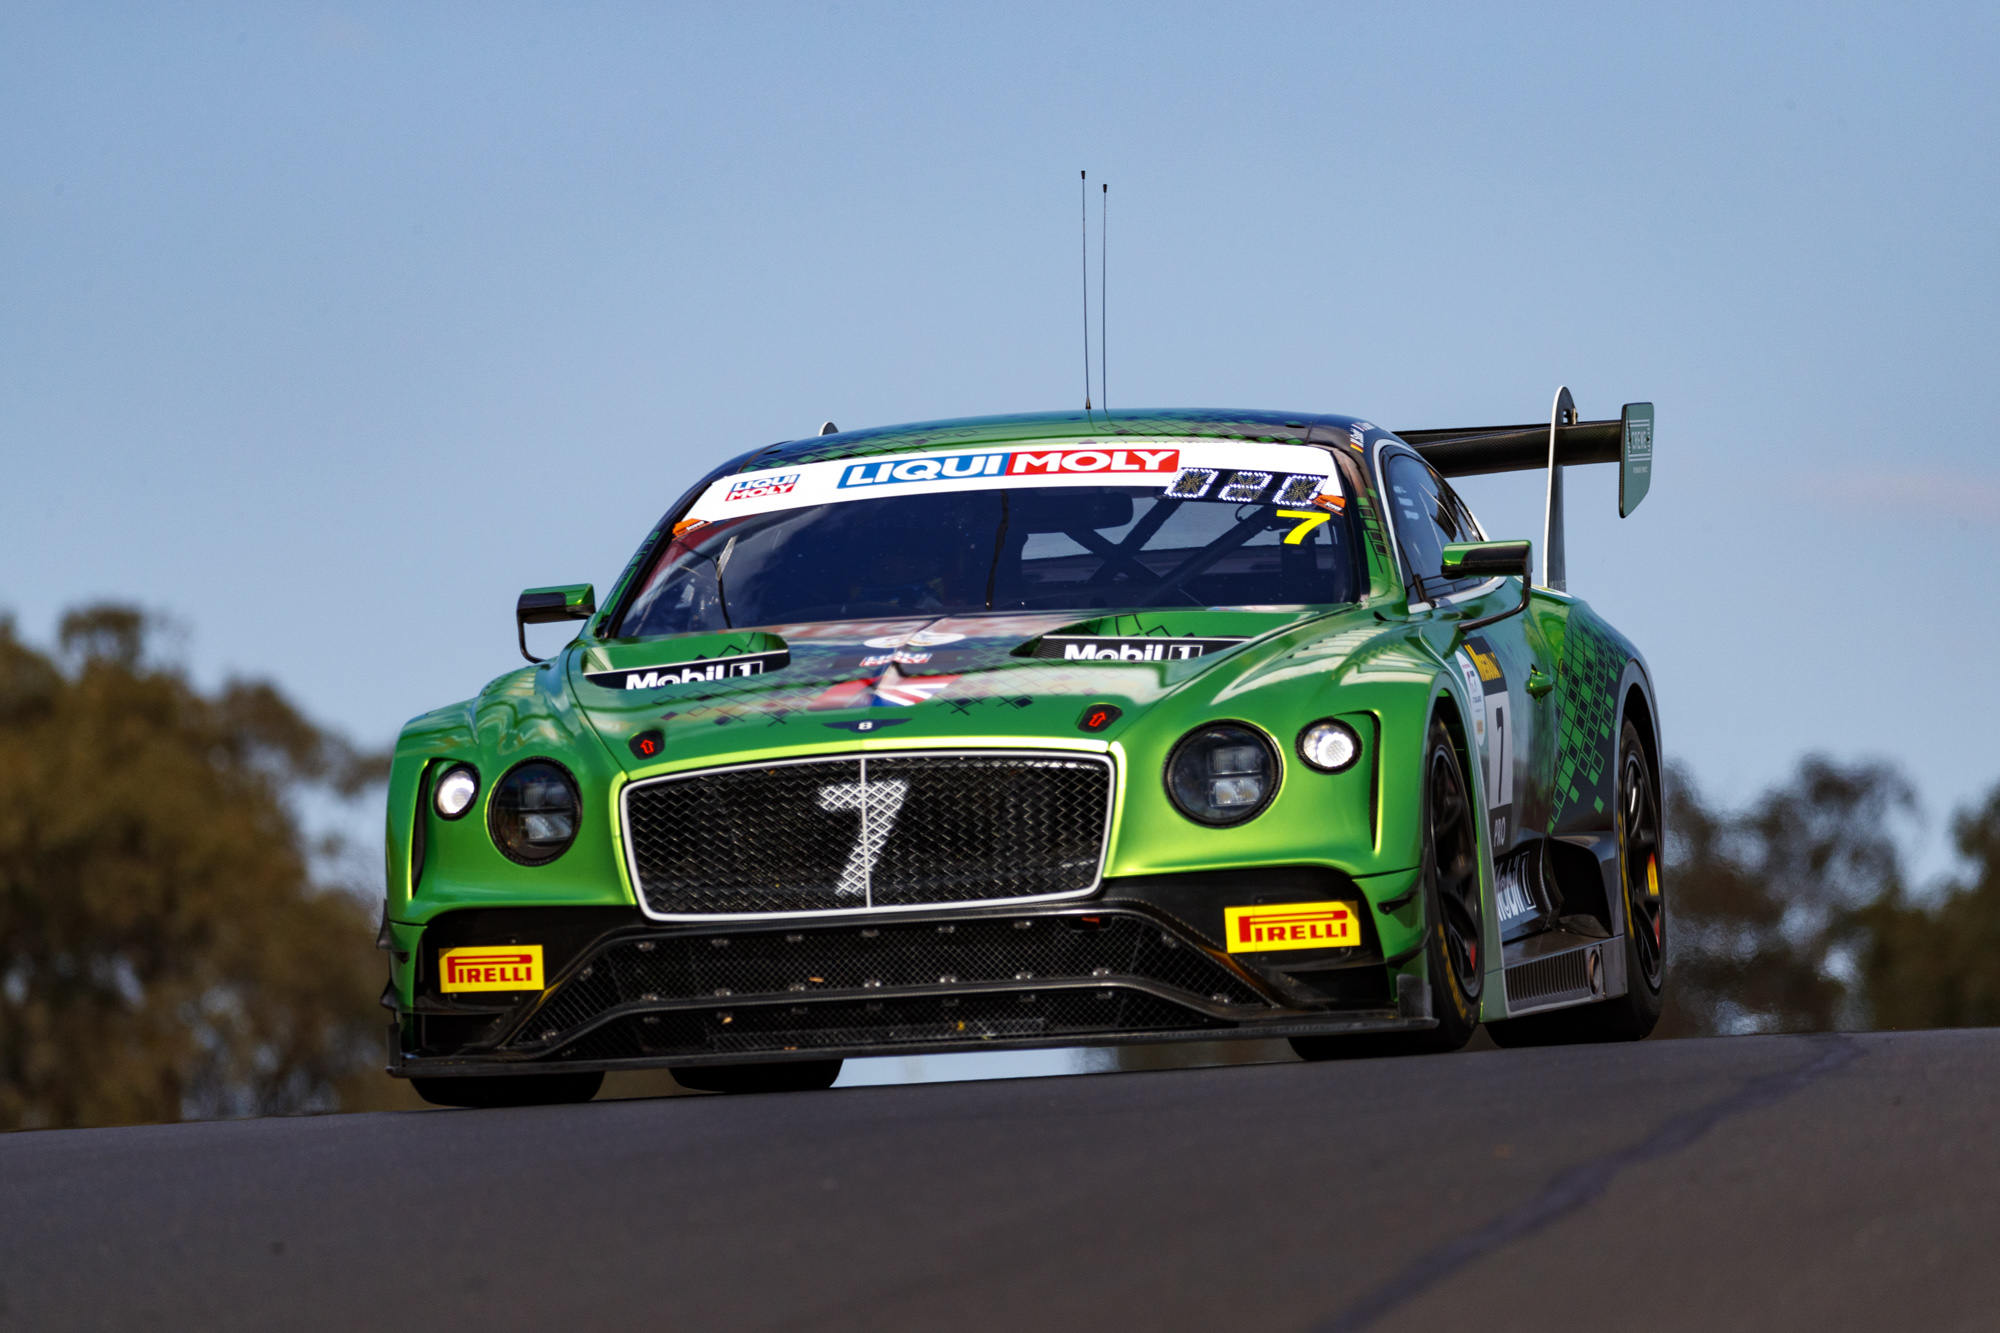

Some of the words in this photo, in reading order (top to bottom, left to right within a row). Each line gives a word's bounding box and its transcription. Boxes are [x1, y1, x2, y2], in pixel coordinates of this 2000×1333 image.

[732, 475, 799, 491] LIQUI
[845, 455, 1003, 486] LIQUI
[1012, 451, 1176, 473] MOLY
[728, 483, 796, 500] MOLY
[1276, 509, 1331, 545] 7
[1064, 644, 1164, 661] Mobil
[1178, 646, 1191, 660] 1
[626, 665, 725, 690] Mobil
[739, 664, 752, 677] 1
[816, 779, 910, 898] 7
[1494, 816, 1506, 848] PRO
[1238, 910, 1348, 943] PIRELLI
[447, 954, 533, 983] PIRELLI
